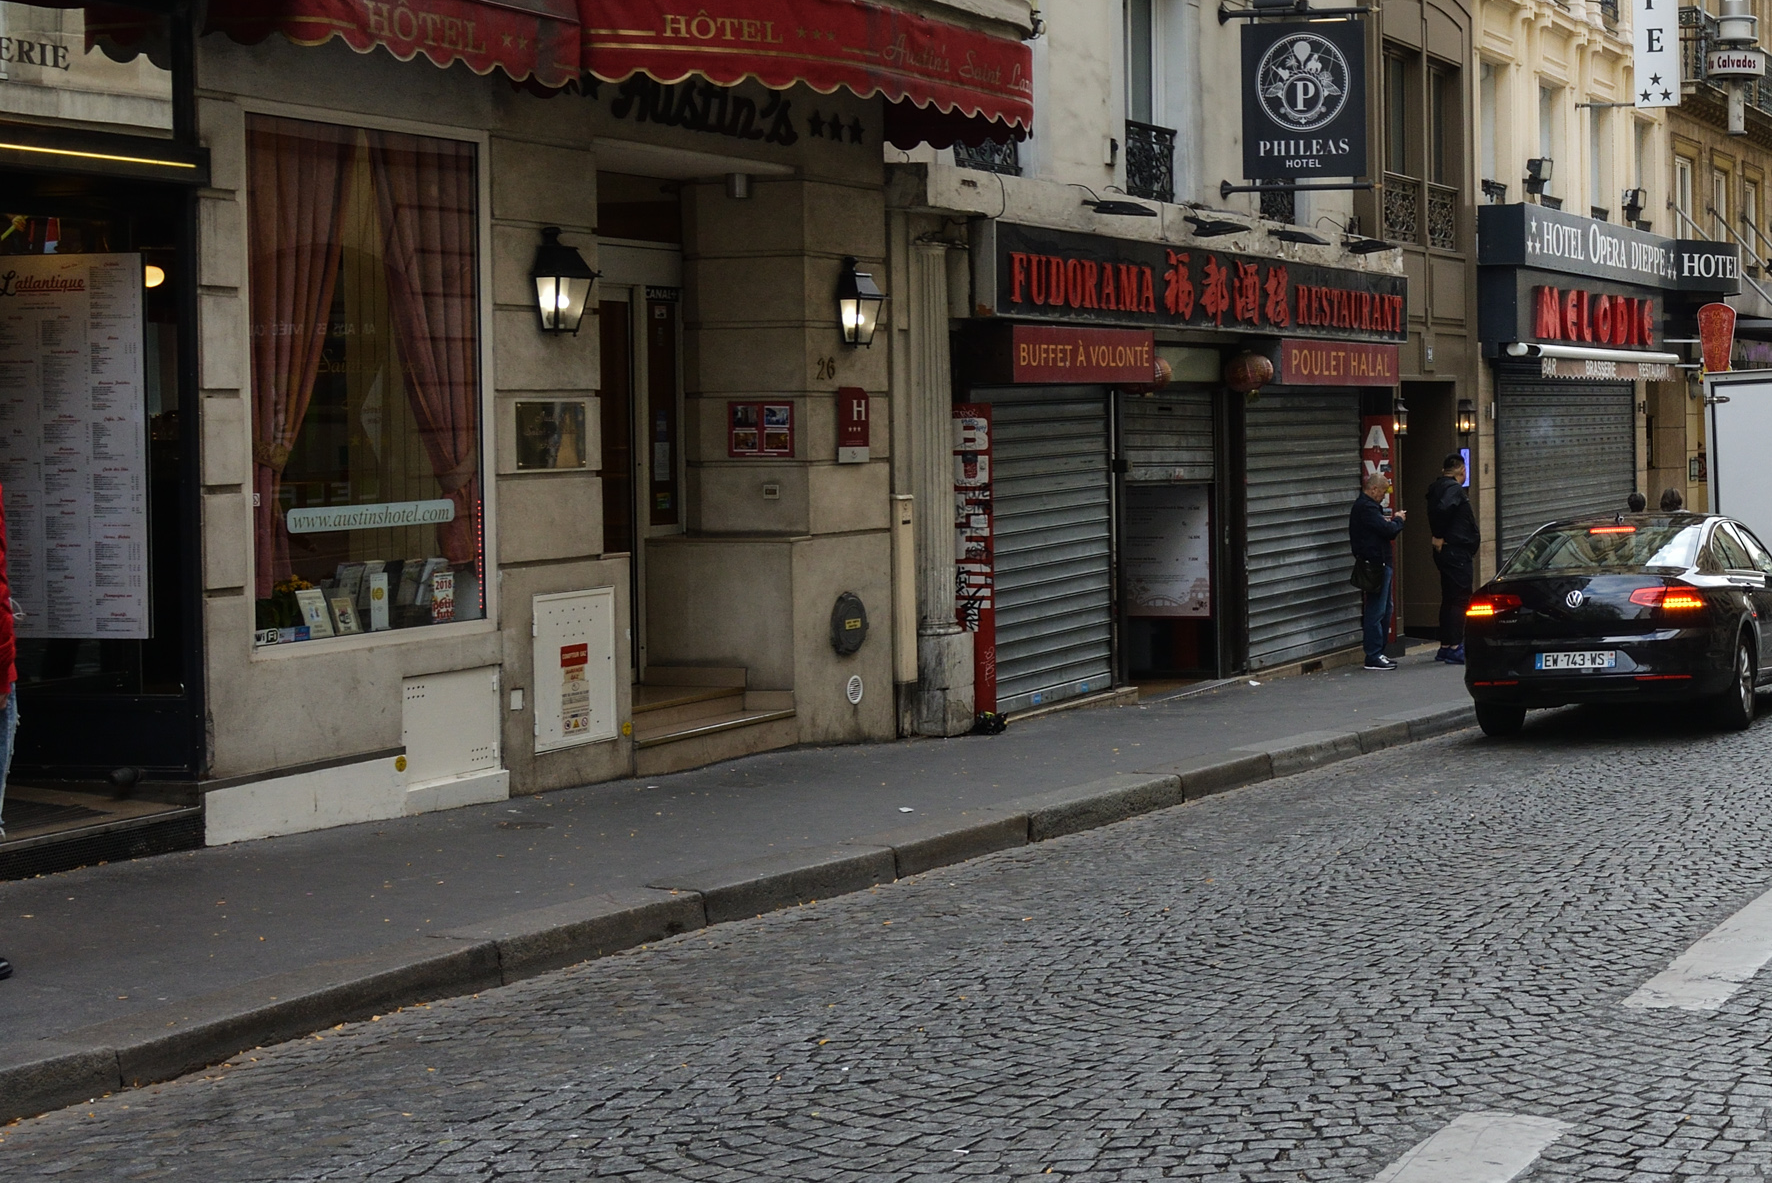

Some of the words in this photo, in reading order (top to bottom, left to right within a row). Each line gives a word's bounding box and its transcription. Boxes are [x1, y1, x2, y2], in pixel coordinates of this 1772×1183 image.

[662, 9, 783, 45] HÔTEL
[883, 32, 950, 74] Austin's
[958, 51, 1001, 88] Saint
[1717, 54, 1756, 69] Calvados
[1295, 80, 1316, 111] P
[611, 76, 799, 146] Austin's
[1259, 138, 1350, 157] PHILEAS
[1285, 158, 1322, 169] HOTEL
[1543, 221, 1585, 261] HOTEL
[1631, 241, 1666, 277] DIEPPE
[1682, 252, 1739, 279] HOTEL
[1009, 251, 1157, 314] FUDORAMA
[1164, 248, 1291, 328] 福都酒樓
[1296, 284, 1403, 333] RESTAURANT
[1536, 285, 1655, 346] MELODIE
[1019, 343, 1073, 367] BUFFET
[1077, 339, 1087, 366] À
[1090, 340, 1151, 367] VOLONTÉ
[1291, 351, 1346, 375] POULET
[1351, 354, 1391, 377] HALAL
[816, 356, 835, 380] 26
[1542, 357, 1557, 375] BAR
[1585, 360, 1616, 377] BRASSERIE
[1638, 362, 1670, 377] RESTAURANT
[852, 399, 866, 421] H
[293, 504, 449, 530] www.austinshotel.com
[435, 580, 452, 591] 2018
[433, 597, 455, 612] petit
[1544, 653, 1604, 667] EW-743-WS
